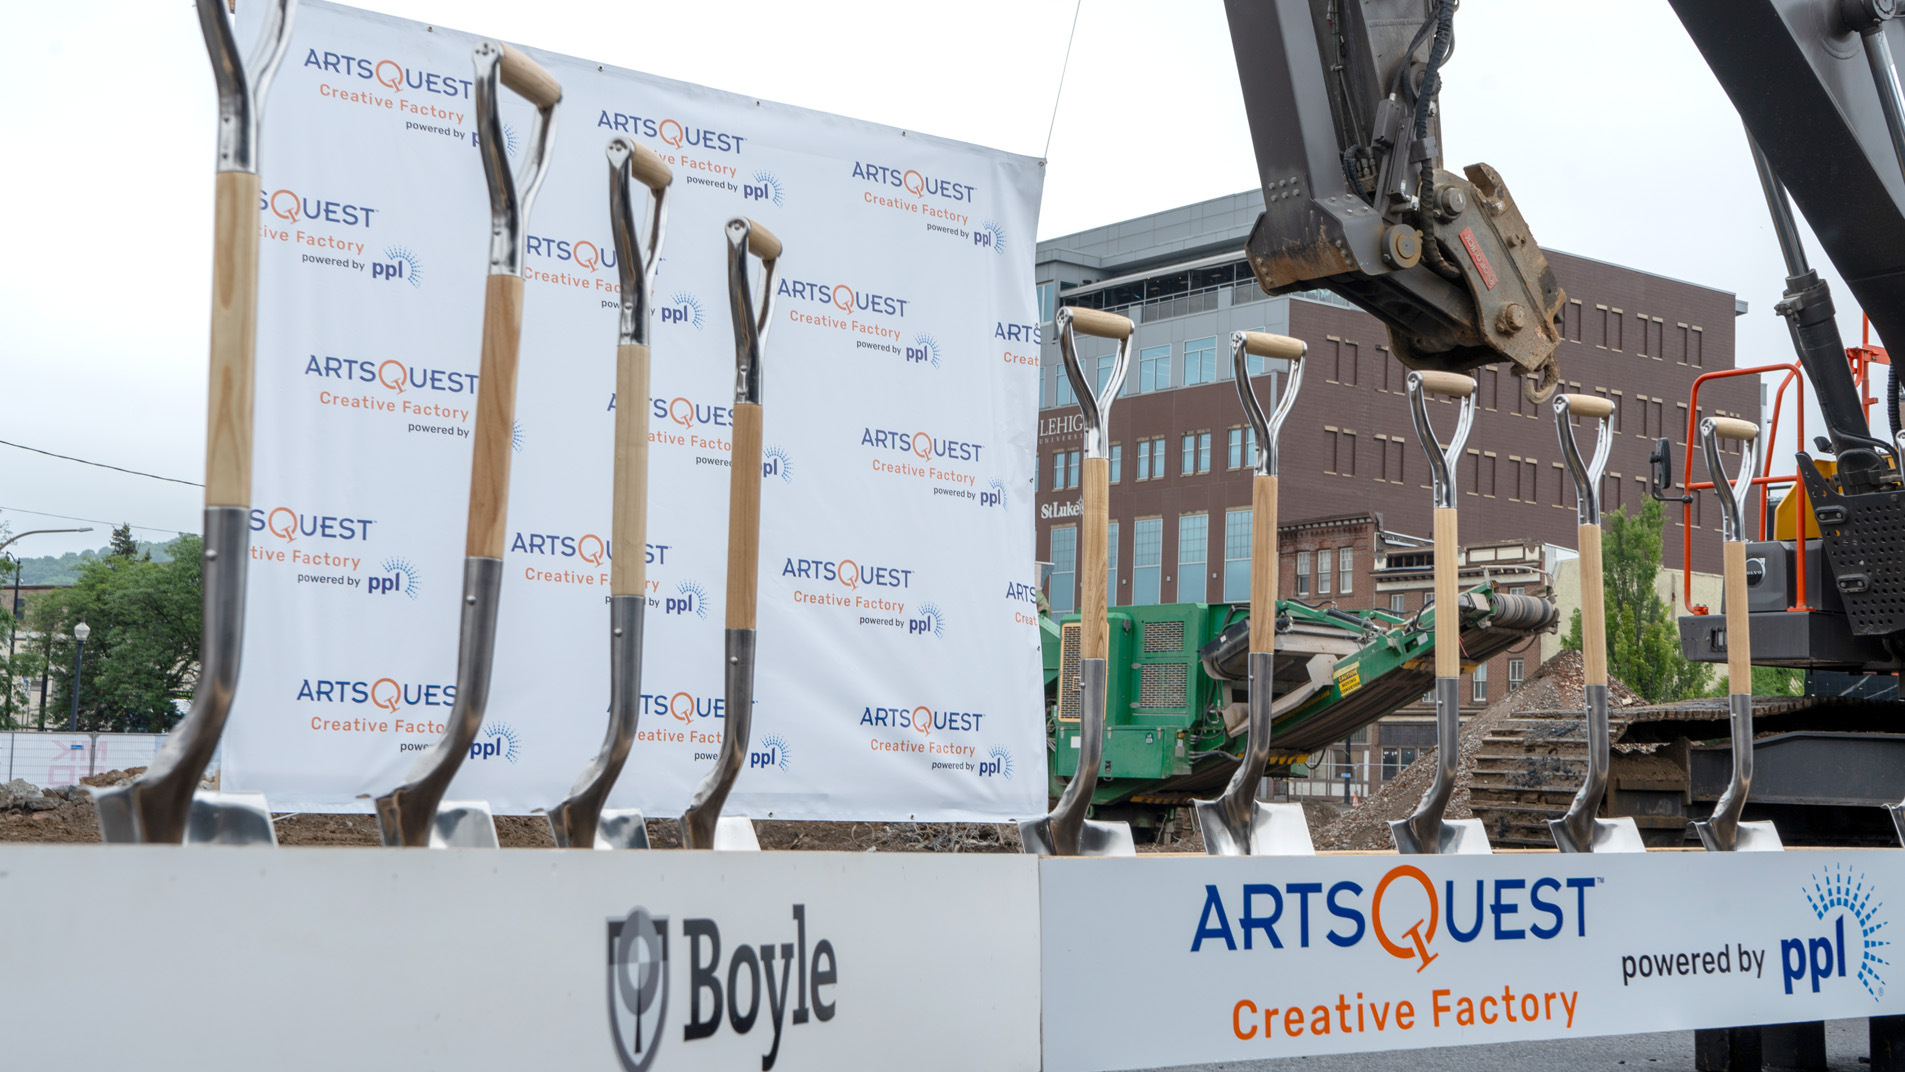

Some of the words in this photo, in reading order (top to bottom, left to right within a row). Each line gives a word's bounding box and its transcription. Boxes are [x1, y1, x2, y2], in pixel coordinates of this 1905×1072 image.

[304, 48, 474, 99] ARTSQUEST
[319, 83, 394, 109] Creative
[400, 99, 464, 125] Factory
[406, 121, 451, 136] powered
[453, 128, 466, 140] by
[597, 110, 744, 154] ARTSQUEST
[681, 155, 737, 178] Factory
[686, 176, 725, 189] powered
[727, 182, 738, 193] by
[743, 183, 769, 201] ppl
[852, 161, 975, 203] ARTSQUEST
[259, 188, 375, 228] SQUEST
[863, 192, 918, 213] Creative
[922, 203, 968, 225] Factory
[296, 230, 364, 256] Factory
[927, 223, 959, 236] powered
[960, 229, 970, 240] by
[973, 231, 992, 247] ppl
[302, 254, 348, 268] powered
[348, 259, 365, 272] by
[372, 260, 403, 281] ppl
[526, 234, 661, 275] RTSQU
[524, 266, 590, 289] Creative
[777, 278, 908, 318] ARTSQUEST
[661, 305, 688, 324] ppl
[789, 309, 848, 331] Creative
[851, 319, 901, 342] Factory
[856, 340, 891, 353] powered
[892, 345, 902, 356] by
[906, 345, 928, 363] ppl
[305, 354, 479, 394] ARTSQUEST
[319, 391, 396, 412] Creative
[402, 400, 469, 423] Factory
[606, 391, 733, 430] ASQUE
[408, 423, 454, 436] powered
[457, 426, 470, 439] by
[1040, 414, 1083, 436] LEHIG
[648, 430, 685, 446] ative
[691, 435, 731, 452] Facto
[861, 428, 983, 463] ARTSQUEST
[1039, 433, 1083, 445] UNIVERSI
[761, 458, 778, 478] pl
[872, 459, 926, 478] Creative
[929, 467, 976, 487] Factory
[933, 486, 965, 498] powered
[966, 490, 976, 501] by
[980, 488, 1001, 508] ppl
[249, 506, 374, 544] SQUEST
[250, 546, 286, 562] tive
[292, 549, 361, 572] Factory
[511, 532, 669, 566] ARTSQST
[297, 573, 345, 586] powered
[347, 576, 361, 588] by
[368, 571, 400, 595] ppl
[525, 567, 594, 586] Creative
[782, 557, 913, 592] ARTSQUEST
[649, 597, 660, 609] by
[666, 594, 692, 615] ppl
[793, 590, 851, 607] Creative
[855, 596, 905, 615] Factory
[859, 616, 894, 628] powered
[895, 618, 905, 629] by
[909, 615, 931, 635] ppl
[297, 677, 457, 714] ARTSQUES
[311, 716, 388, 733] Creative
[395, 719, 445, 734] Facto
[860, 706, 984, 737] ARTSQUEST
[470, 737, 501, 760] ppl
[638, 729, 684, 743] eative
[690, 731, 722, 744] Fact
[871, 739, 925, 753] Creative
[929, 741, 976, 758] Factory
[694, 752, 718, 761] powe
[751, 748, 775, 768] ppl
[931, 761, 964, 771] powered
[965, 761, 975, 772] by
[979, 757, 1001, 777] ppl
[1621, 942, 1732, 986] powered
[1739, 943, 1766, 979] by
[1780, 912, 1848, 995] ppl
[683, 903, 838, 1072] Boyle
[1232, 992, 1416, 1040] Creative
[1433, 985, 1579, 1030] Factory
